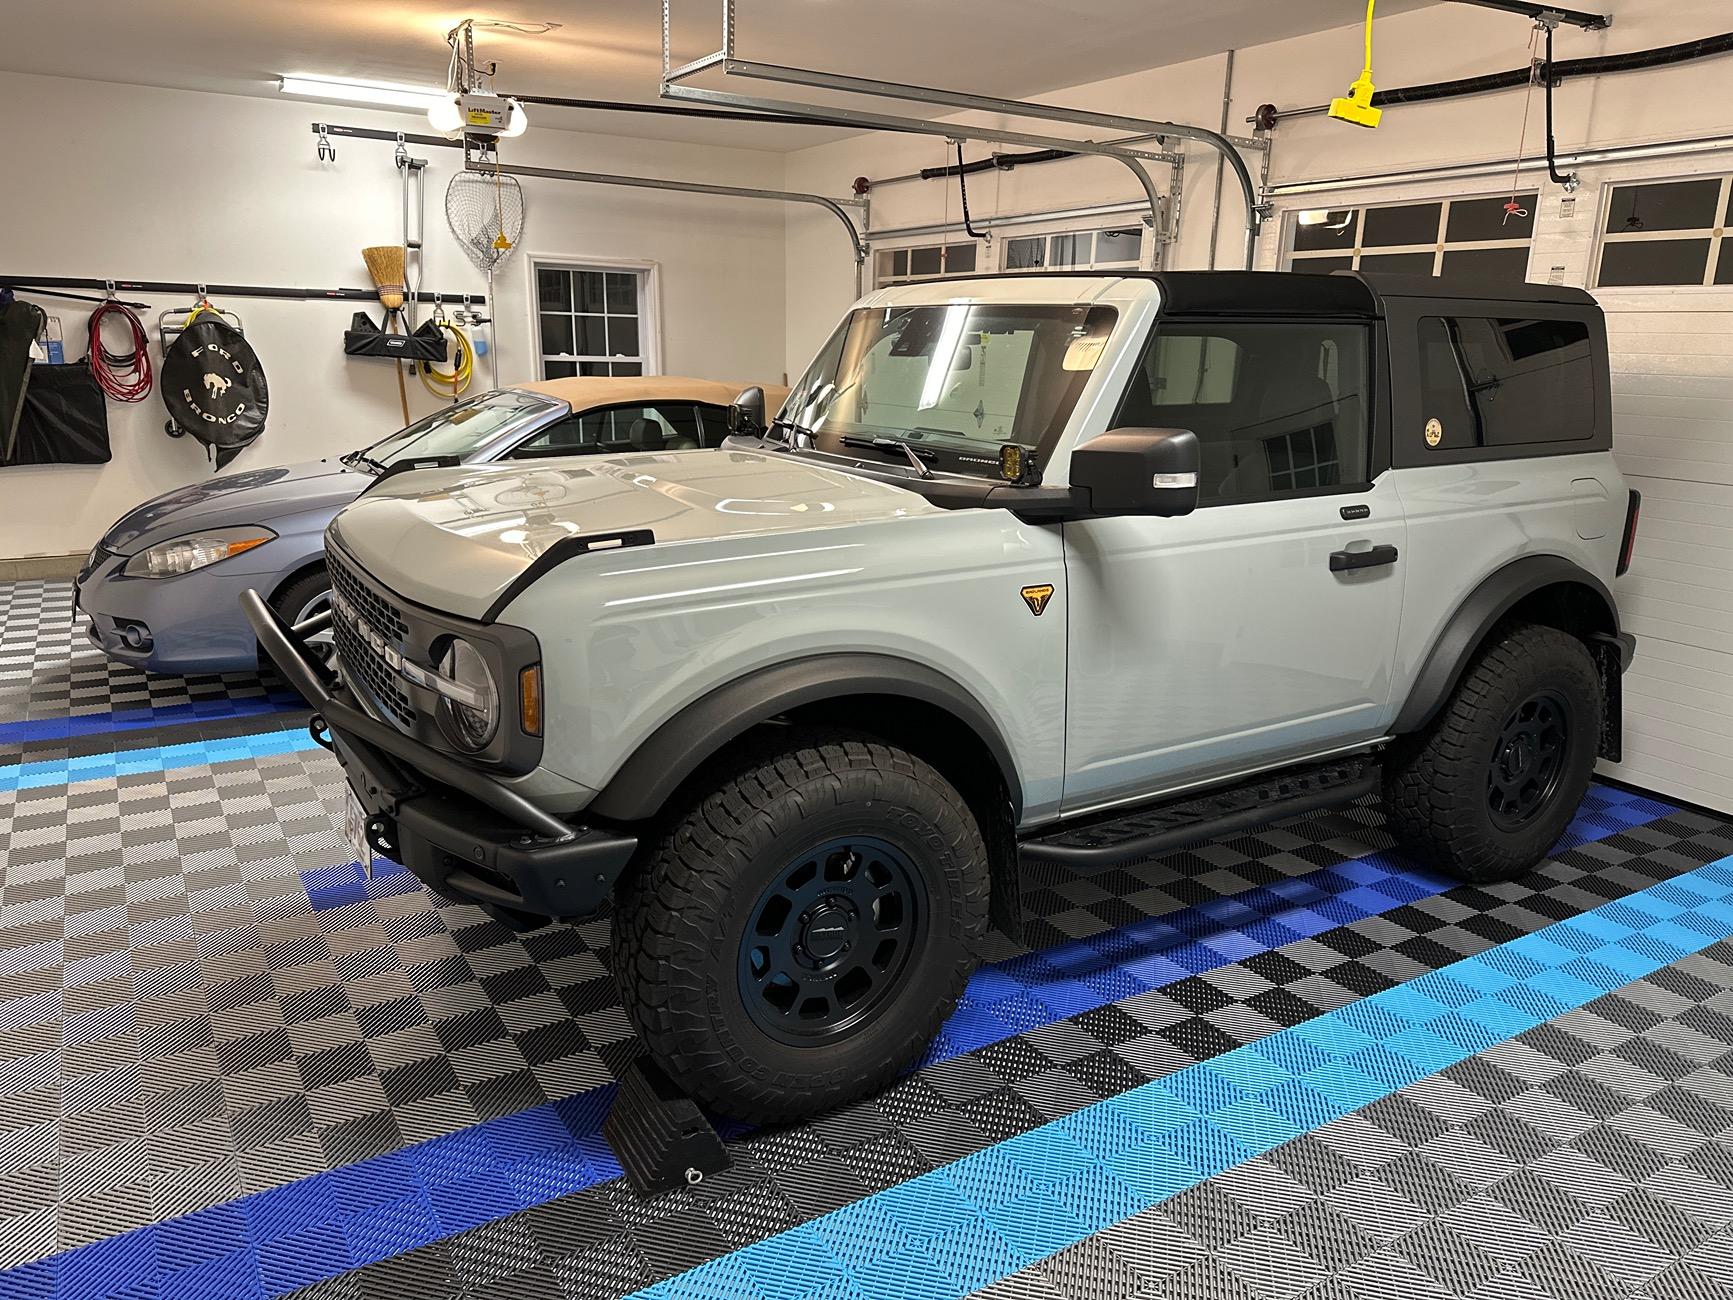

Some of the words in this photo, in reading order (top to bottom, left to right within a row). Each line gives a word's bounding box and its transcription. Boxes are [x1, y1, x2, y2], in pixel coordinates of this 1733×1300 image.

[468, 107, 501, 115] LiftMaster
[191, 343, 244, 374] FORD
[183, 388, 246, 425] BRONCO
[886, 805, 945, 851] TOYO
